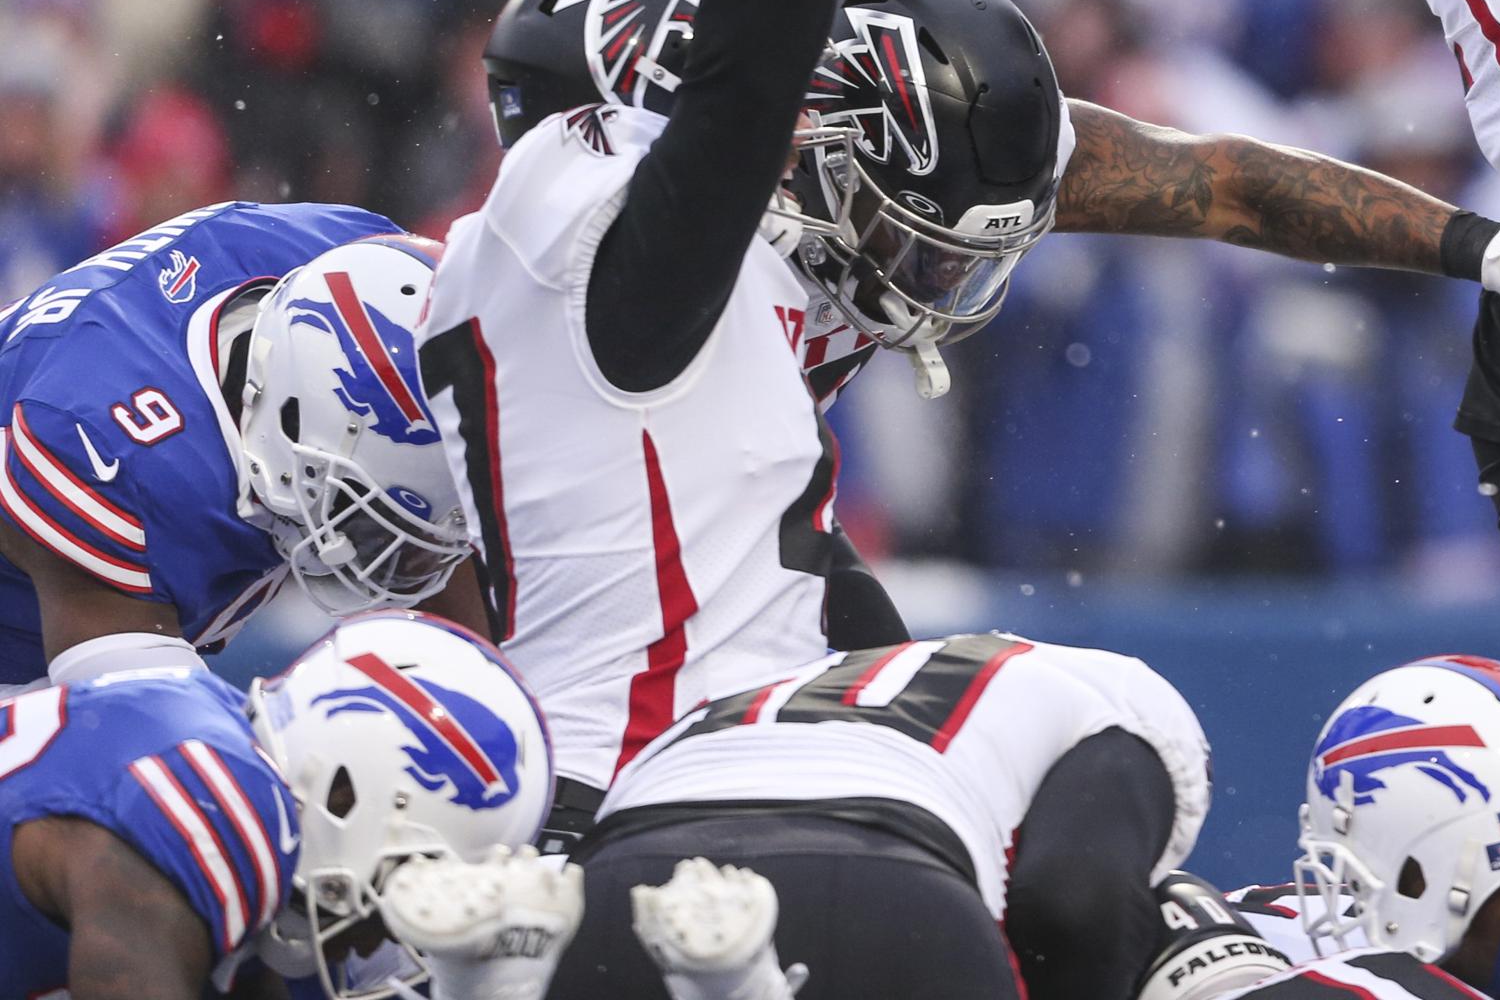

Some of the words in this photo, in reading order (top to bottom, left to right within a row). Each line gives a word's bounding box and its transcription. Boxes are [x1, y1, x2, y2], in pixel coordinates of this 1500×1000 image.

[984, 215, 1022, 230] ATL
[111, 386, 186, 447] 9
[1167, 941, 1294, 988] FALCON
